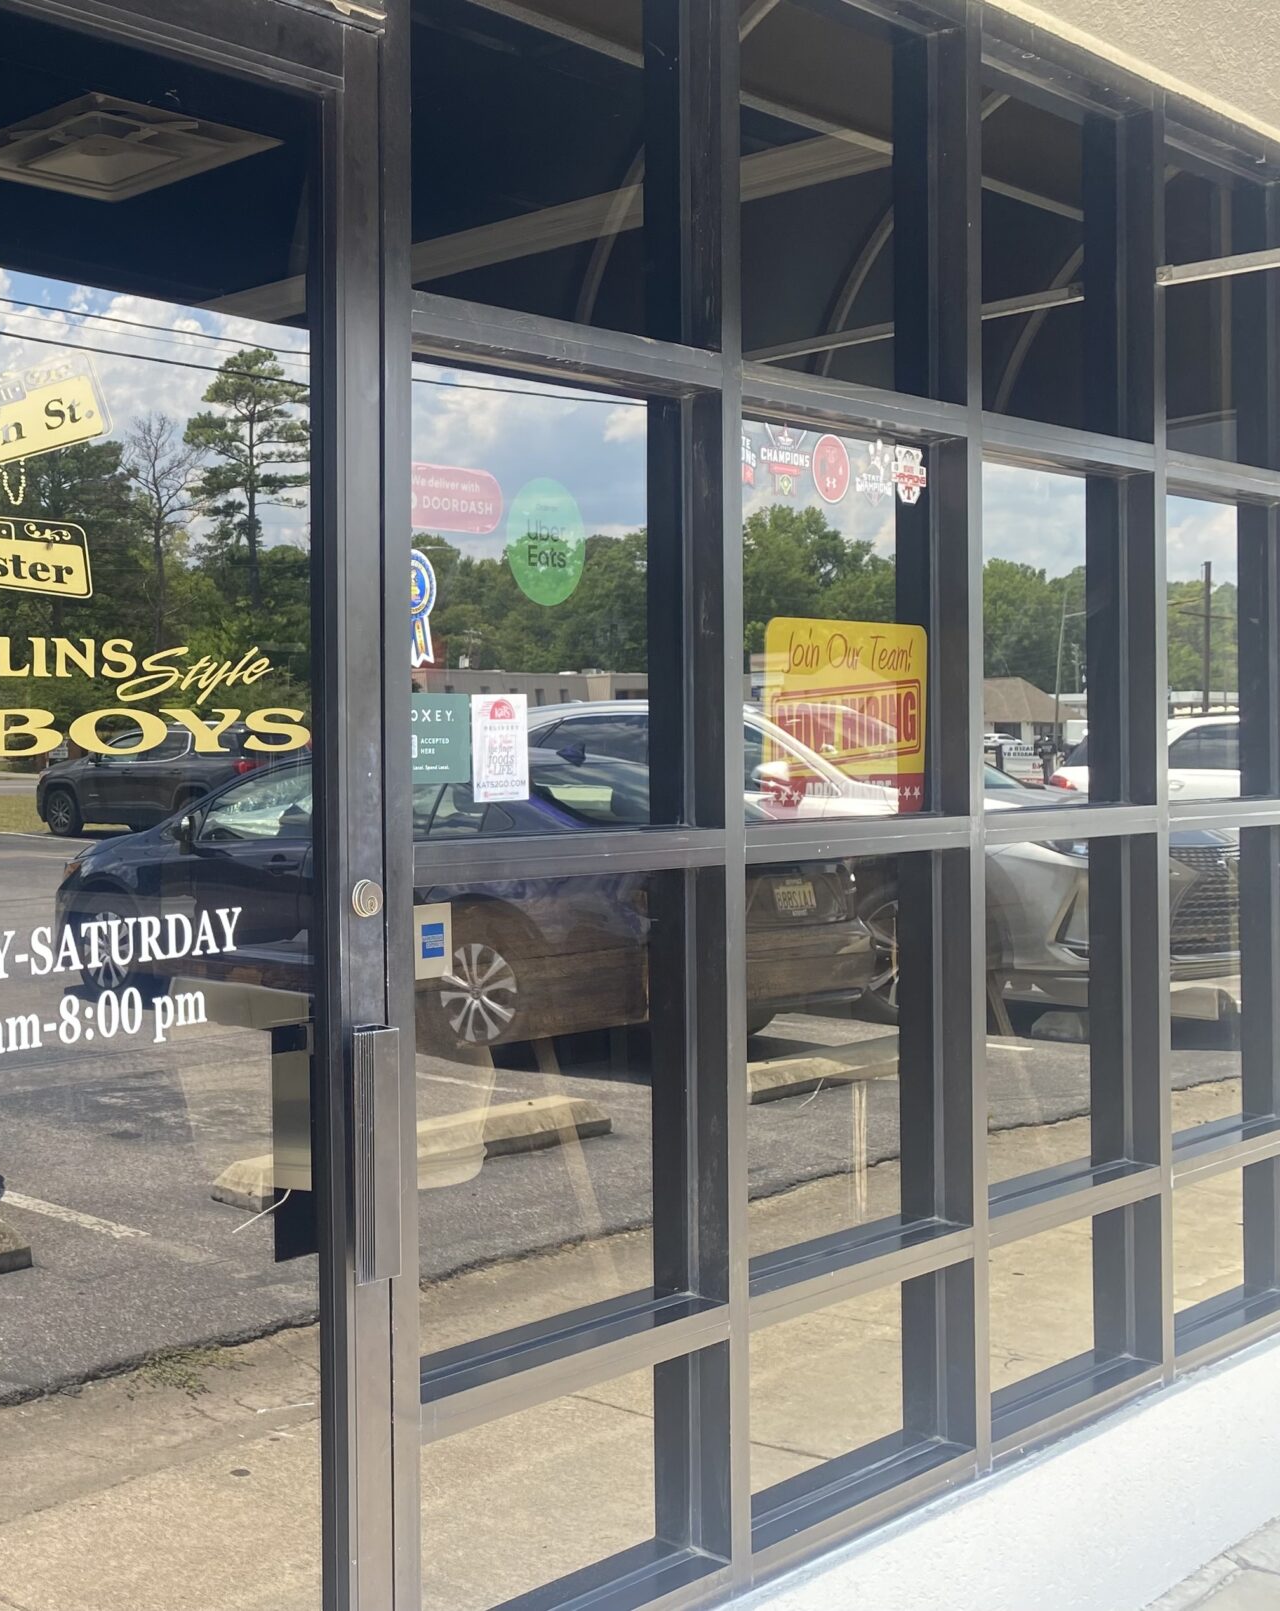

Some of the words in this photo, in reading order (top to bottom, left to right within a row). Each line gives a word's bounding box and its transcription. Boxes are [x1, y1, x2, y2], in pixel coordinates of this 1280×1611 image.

[43, 397, 95, 431] St.
[760, 447, 811, 468] CHAMPIONS
[428, 477, 460, 490] deliver
[460, 480, 480, 493] with
[422, 495, 493, 515] DOORDASH
[527, 544, 567, 569] Eats
[783, 628, 820, 673] Join
[827, 633, 863, 669] Our
[870, 635, 913, 672] Team!
[116, 646, 275, 705] Style
[775, 701, 837, 758] NOW
[841, 690, 917, 750] HIRING
[151, 990, 208, 1043] pm
